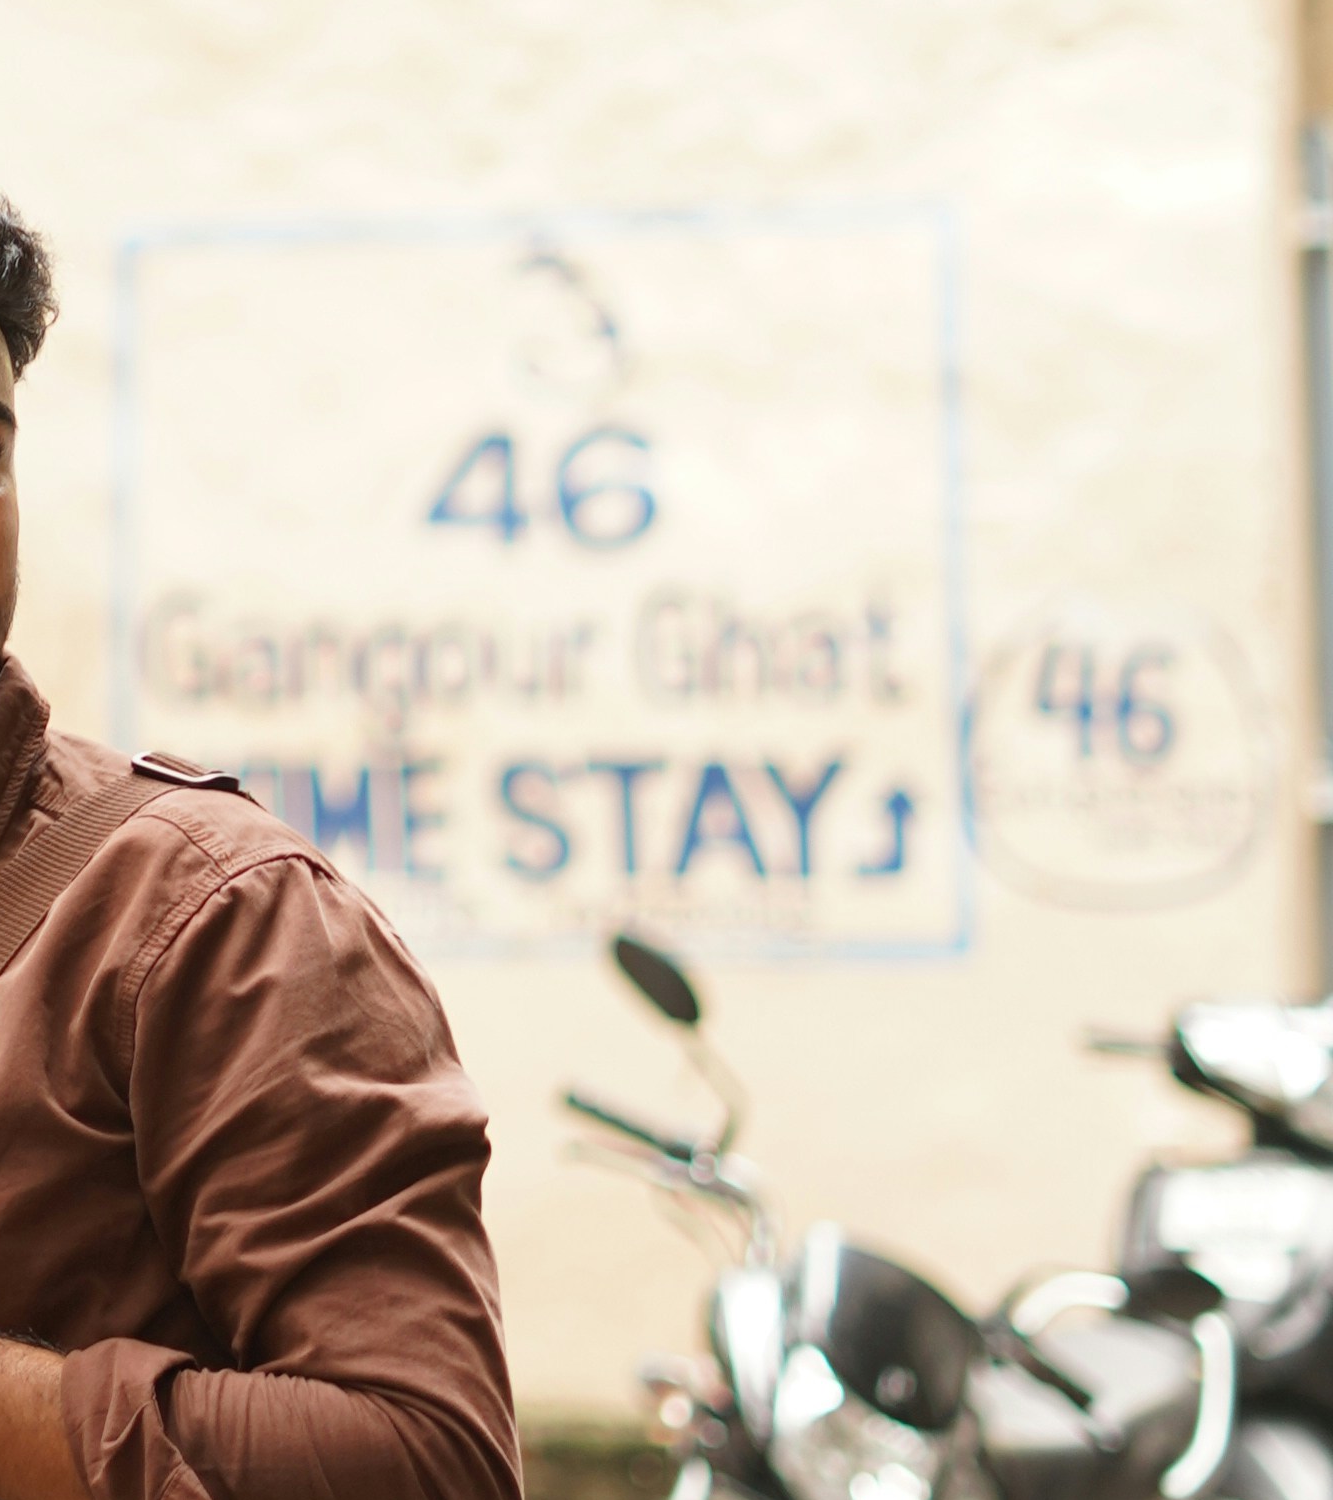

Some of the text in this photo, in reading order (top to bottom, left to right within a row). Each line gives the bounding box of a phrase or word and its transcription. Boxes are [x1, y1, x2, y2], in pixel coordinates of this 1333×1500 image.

[423, 422, 663, 550] 46
[637, 580, 909, 708] Ghat
[1031, 640, 1183, 770] 46
[503, 750, 849, 880] STAY
